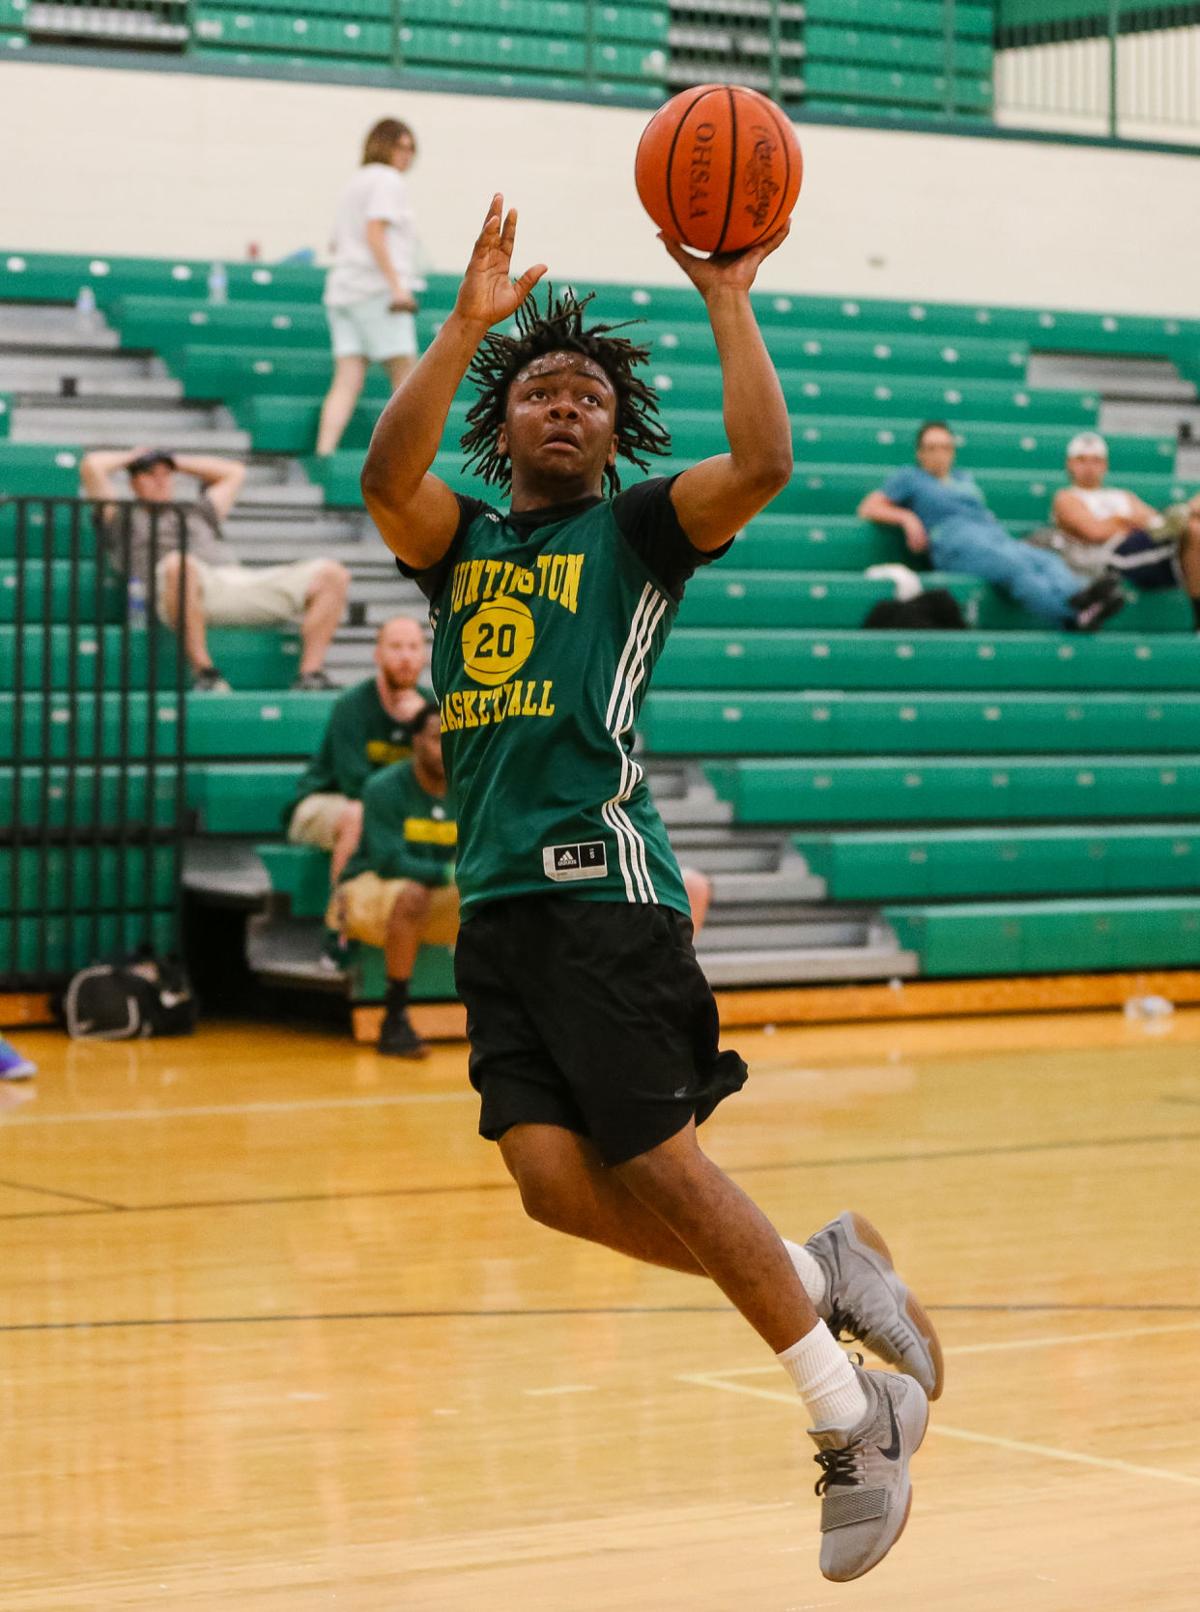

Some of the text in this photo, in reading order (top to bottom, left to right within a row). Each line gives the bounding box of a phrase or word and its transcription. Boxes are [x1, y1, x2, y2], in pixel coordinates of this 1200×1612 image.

[689, 122, 716, 219] OHSAA
[451, 553, 585, 614] UNTINGTON
[474, 622, 517, 659] 20
